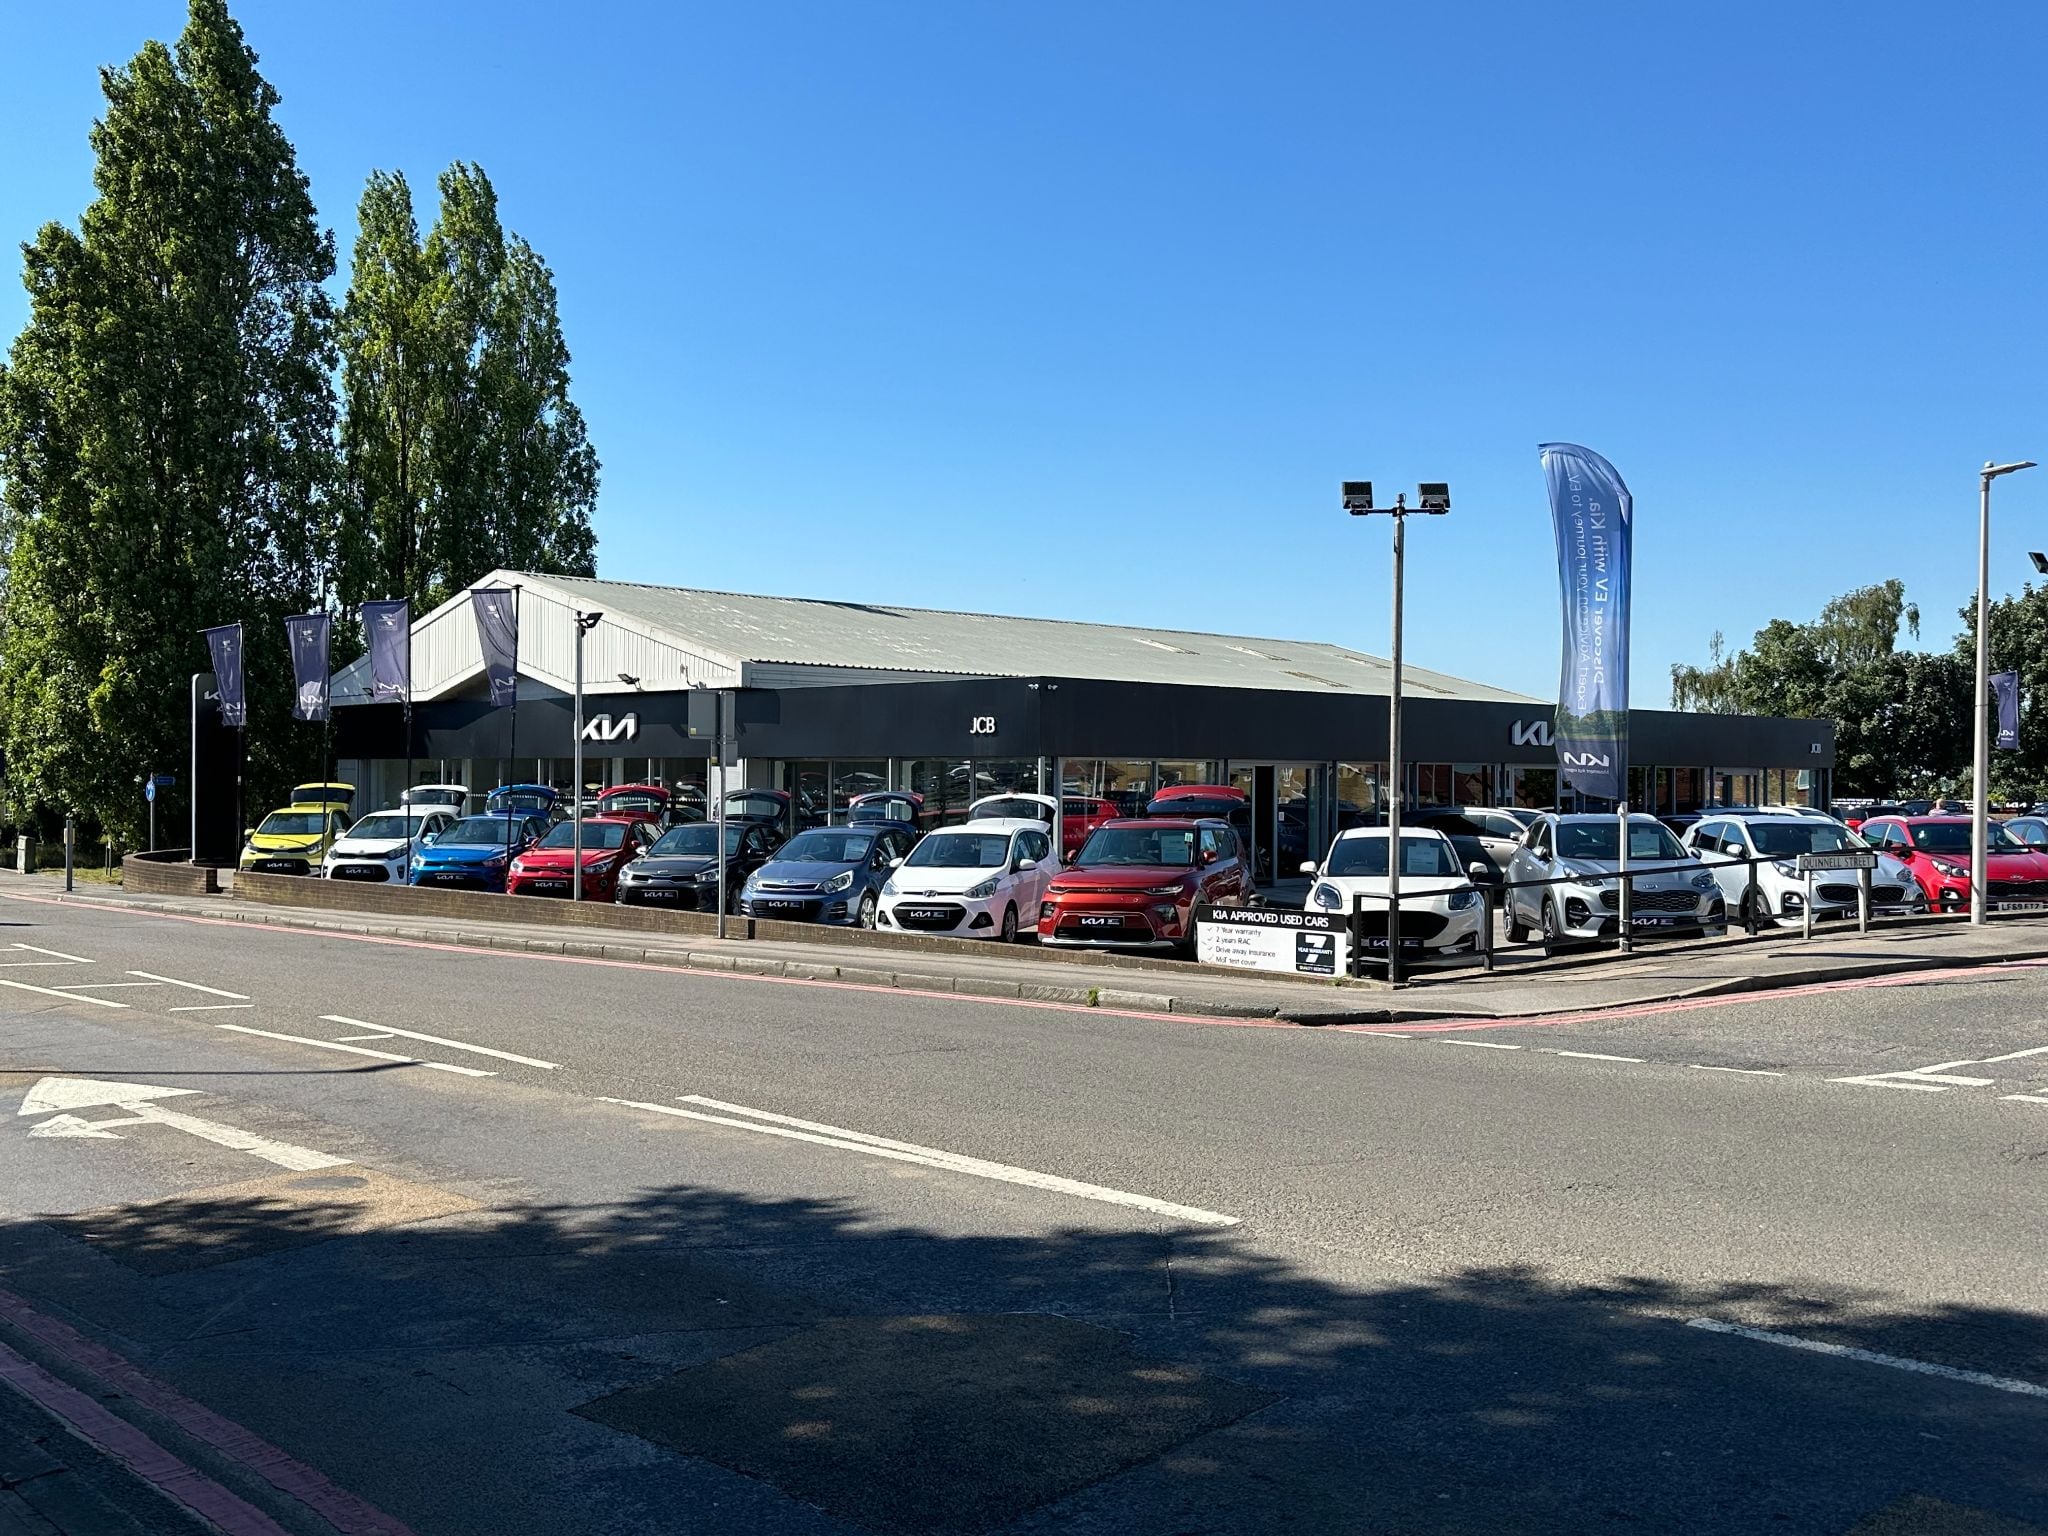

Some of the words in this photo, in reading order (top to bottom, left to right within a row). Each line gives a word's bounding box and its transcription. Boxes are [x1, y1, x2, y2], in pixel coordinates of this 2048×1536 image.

[969, 716, 996, 734] JCB
[1803, 858, 1842, 869] QUINNELL
[1845, 856, 1871, 867] STREET
[1212, 909, 1229, 920] KIA
[1230, 911, 1279, 923] APPROVED
[1280, 914, 1303, 926] USED
[1304, 916, 1329, 928] CARS
[1216, 946, 1231, 954] Drive
